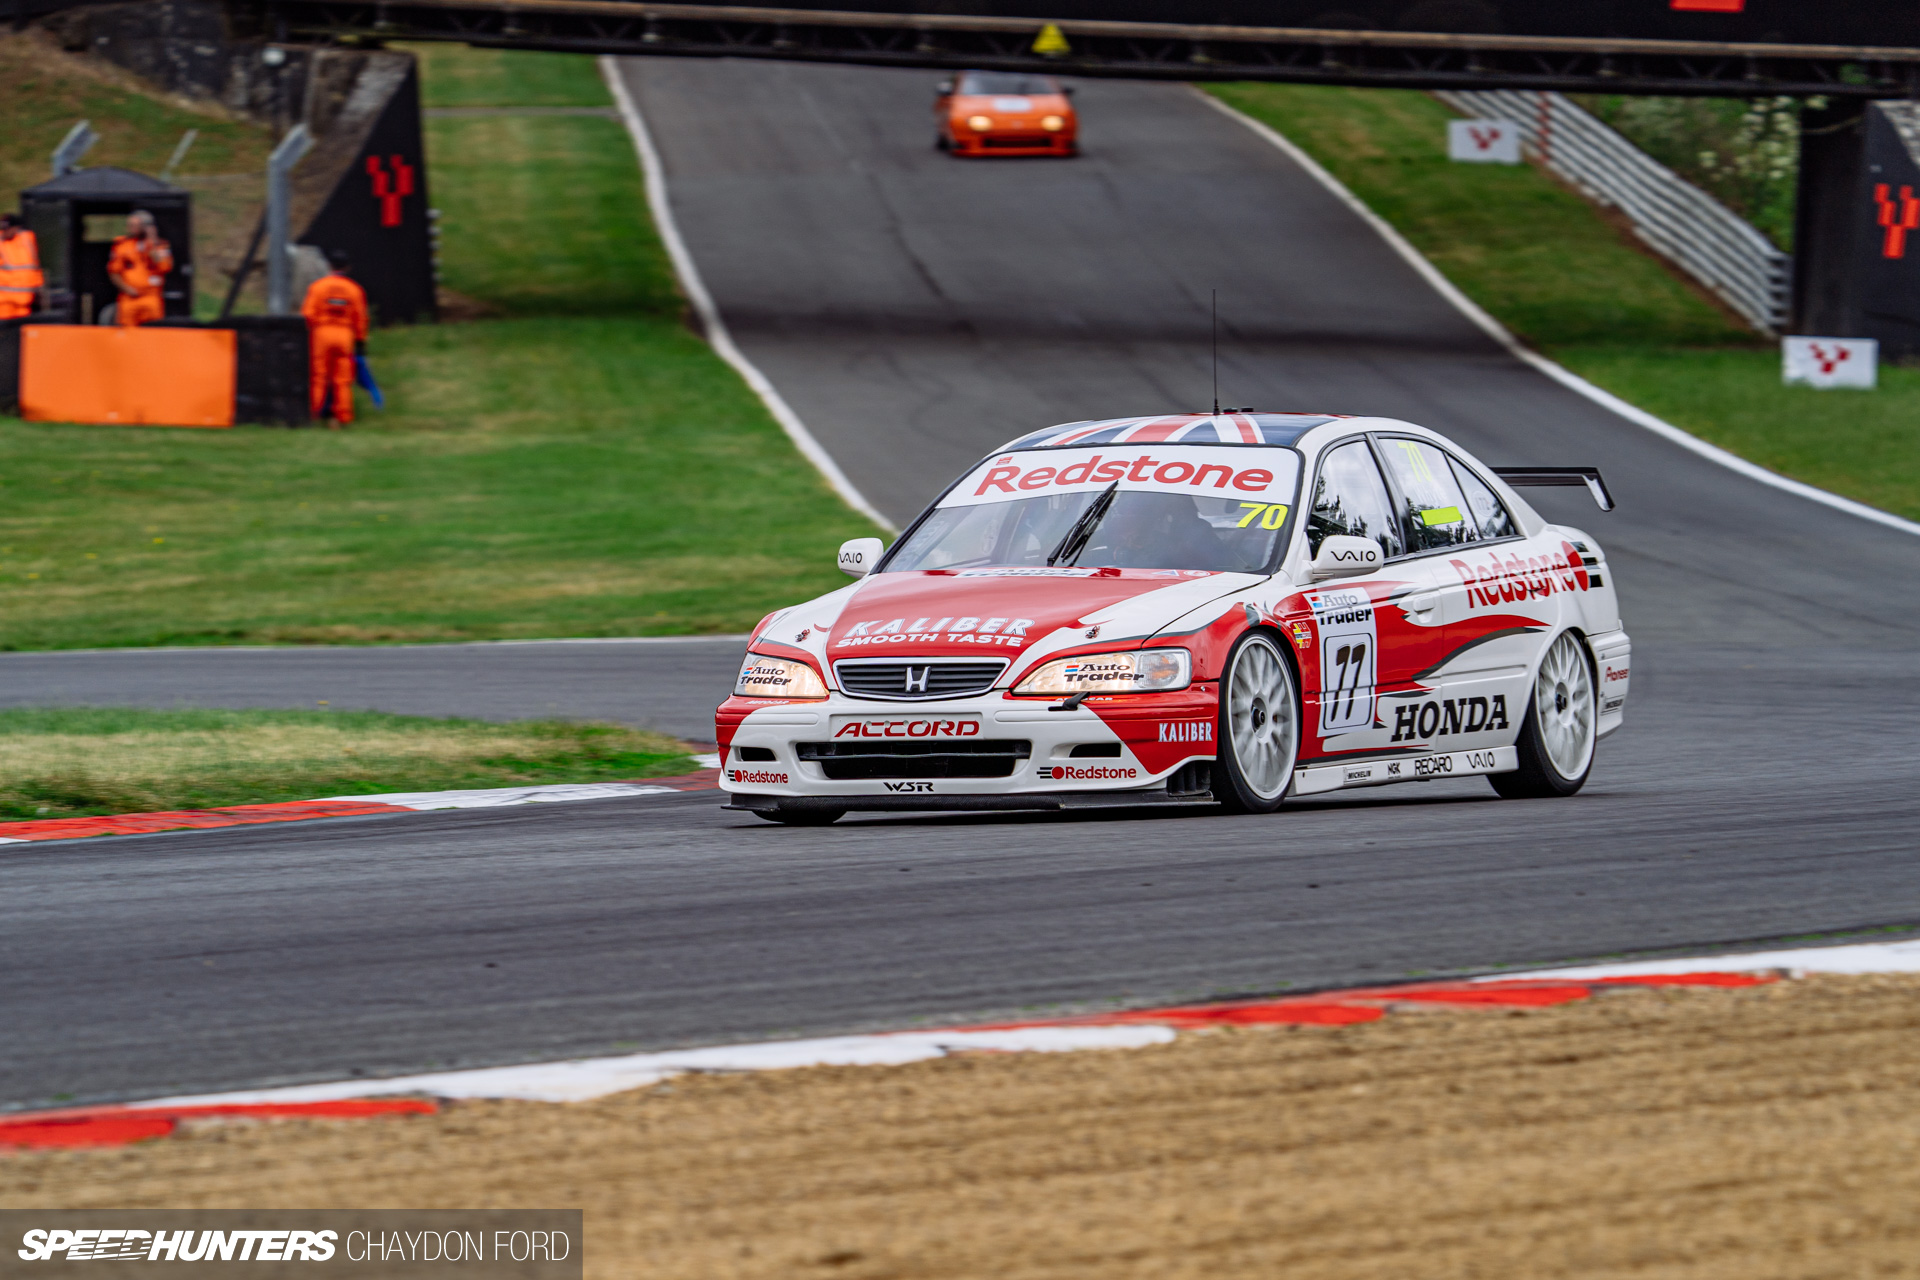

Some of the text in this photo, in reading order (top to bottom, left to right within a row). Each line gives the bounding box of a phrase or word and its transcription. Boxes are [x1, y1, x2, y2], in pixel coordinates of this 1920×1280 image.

[973, 455, 1274, 496] Redstone
[1236, 503, 1288, 530] 70
[839, 552, 862, 564] VAIO
[1331, 551, 1376, 562] VAIO
[1449, 552, 1576, 609] Redstone
[1322, 594, 1358, 607] Auto
[843, 617, 1035, 638] KALIBER
[835, 634, 1024, 648] SMOOTH TASTE
[751, 666, 785, 675] Auto
[1078, 663, 1131, 672] Auto
[740, 676, 792, 686] Trader
[1064, 671, 1144, 682] Trader
[1390, 694, 1510, 742] HONDA
[834, 720, 980, 738] ACCORD
[1158, 722, 1213, 743] KALIBER
[1414, 756, 1453, 776] RECARO
[1467, 752, 1496, 769] VAIO
[1065, 766, 1137, 780] Redstone
[1387, 763, 1401, 775] NGK
[742, 770, 789, 784] Redstone
[883, 781, 934, 792] WSR
